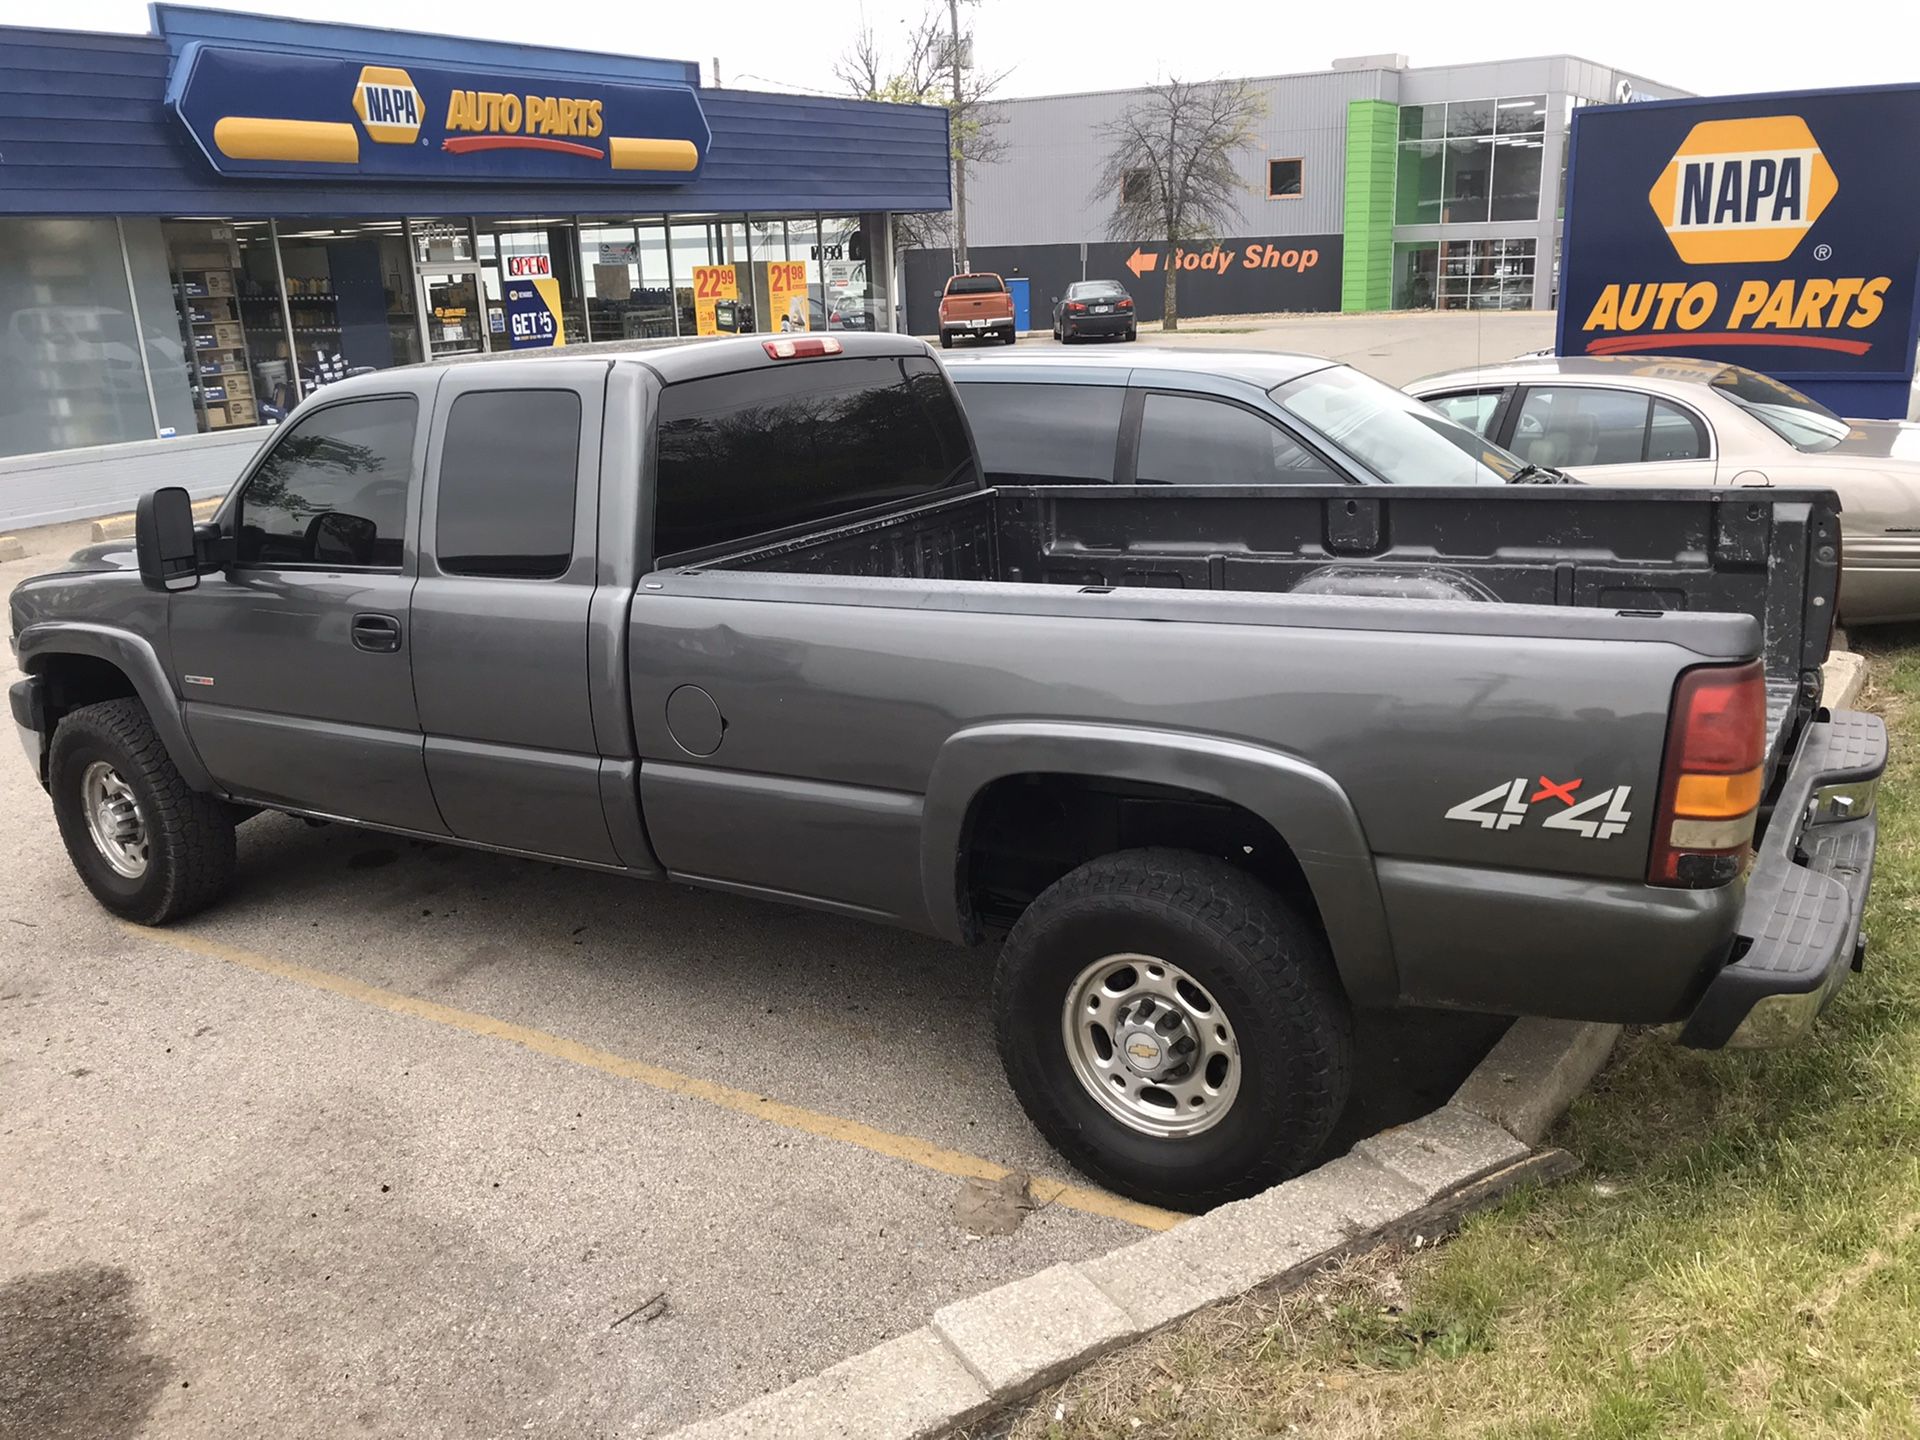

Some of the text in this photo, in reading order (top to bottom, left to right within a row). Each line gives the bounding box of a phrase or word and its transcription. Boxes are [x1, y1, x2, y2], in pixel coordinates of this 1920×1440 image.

[366, 87, 418, 125] NAPA
[446, 90, 604, 138] AUTO PARTS
[1680, 157, 1802, 225] NAPA
[511, 256, 549, 275] OPEN
[1242, 244, 1320, 273] Shop
[1582, 276, 1893, 331] AUTO PARTS
[511, 312, 537, 335] GET
[538, 311, 553, 332] $5
